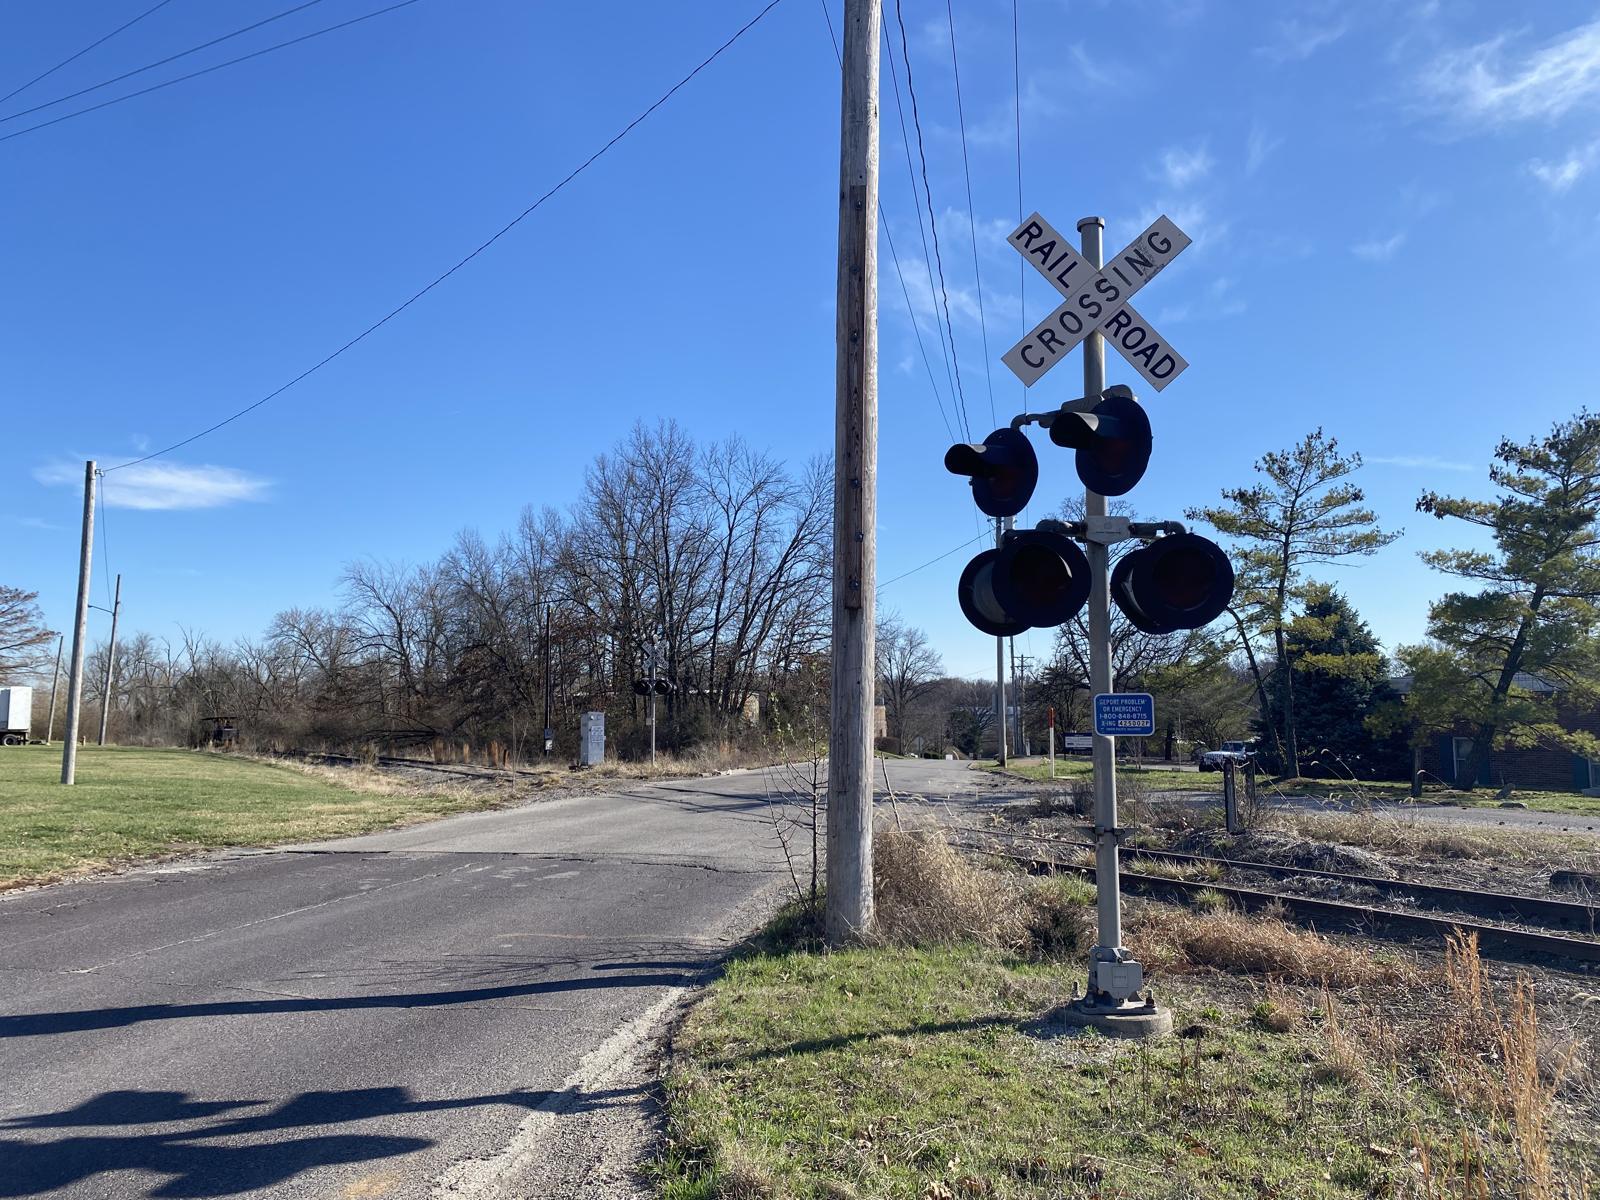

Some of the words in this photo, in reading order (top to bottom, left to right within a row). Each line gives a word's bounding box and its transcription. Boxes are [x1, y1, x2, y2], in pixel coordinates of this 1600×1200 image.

[1015, 221, 1078, 289] RAIL
[1020, 232, 1172, 369] CROSSING
[1104, 309, 1176, 379] ROAD
